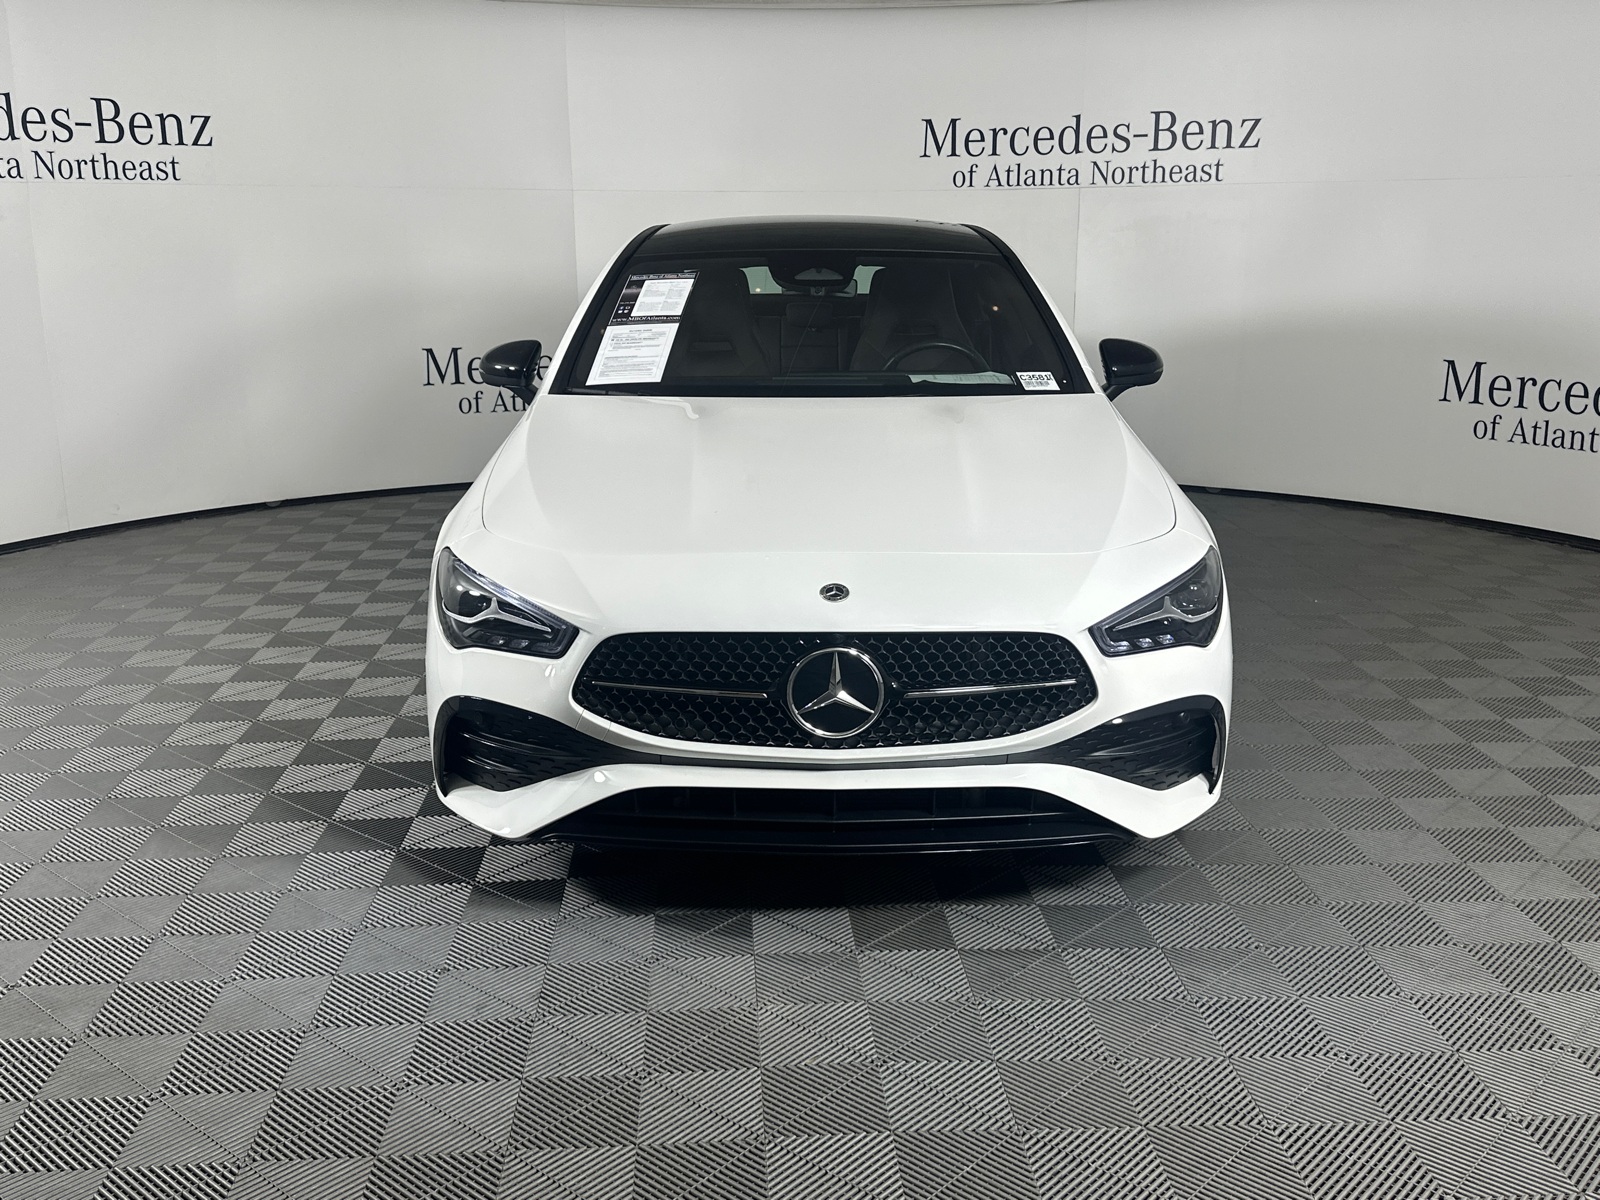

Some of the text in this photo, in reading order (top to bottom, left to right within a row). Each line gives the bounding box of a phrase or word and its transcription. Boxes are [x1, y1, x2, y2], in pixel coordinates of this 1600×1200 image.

[919, 110, 1263, 158] Mercedes-Benz
[31, 150, 181, 181] Northeast
[952, 158, 1225, 188] of Atlanta Northeast
[458, 390, 484, 414] of
[1438, 359, 1600, 417] Merce
[1473, 414, 1600, 453] of Atlant
